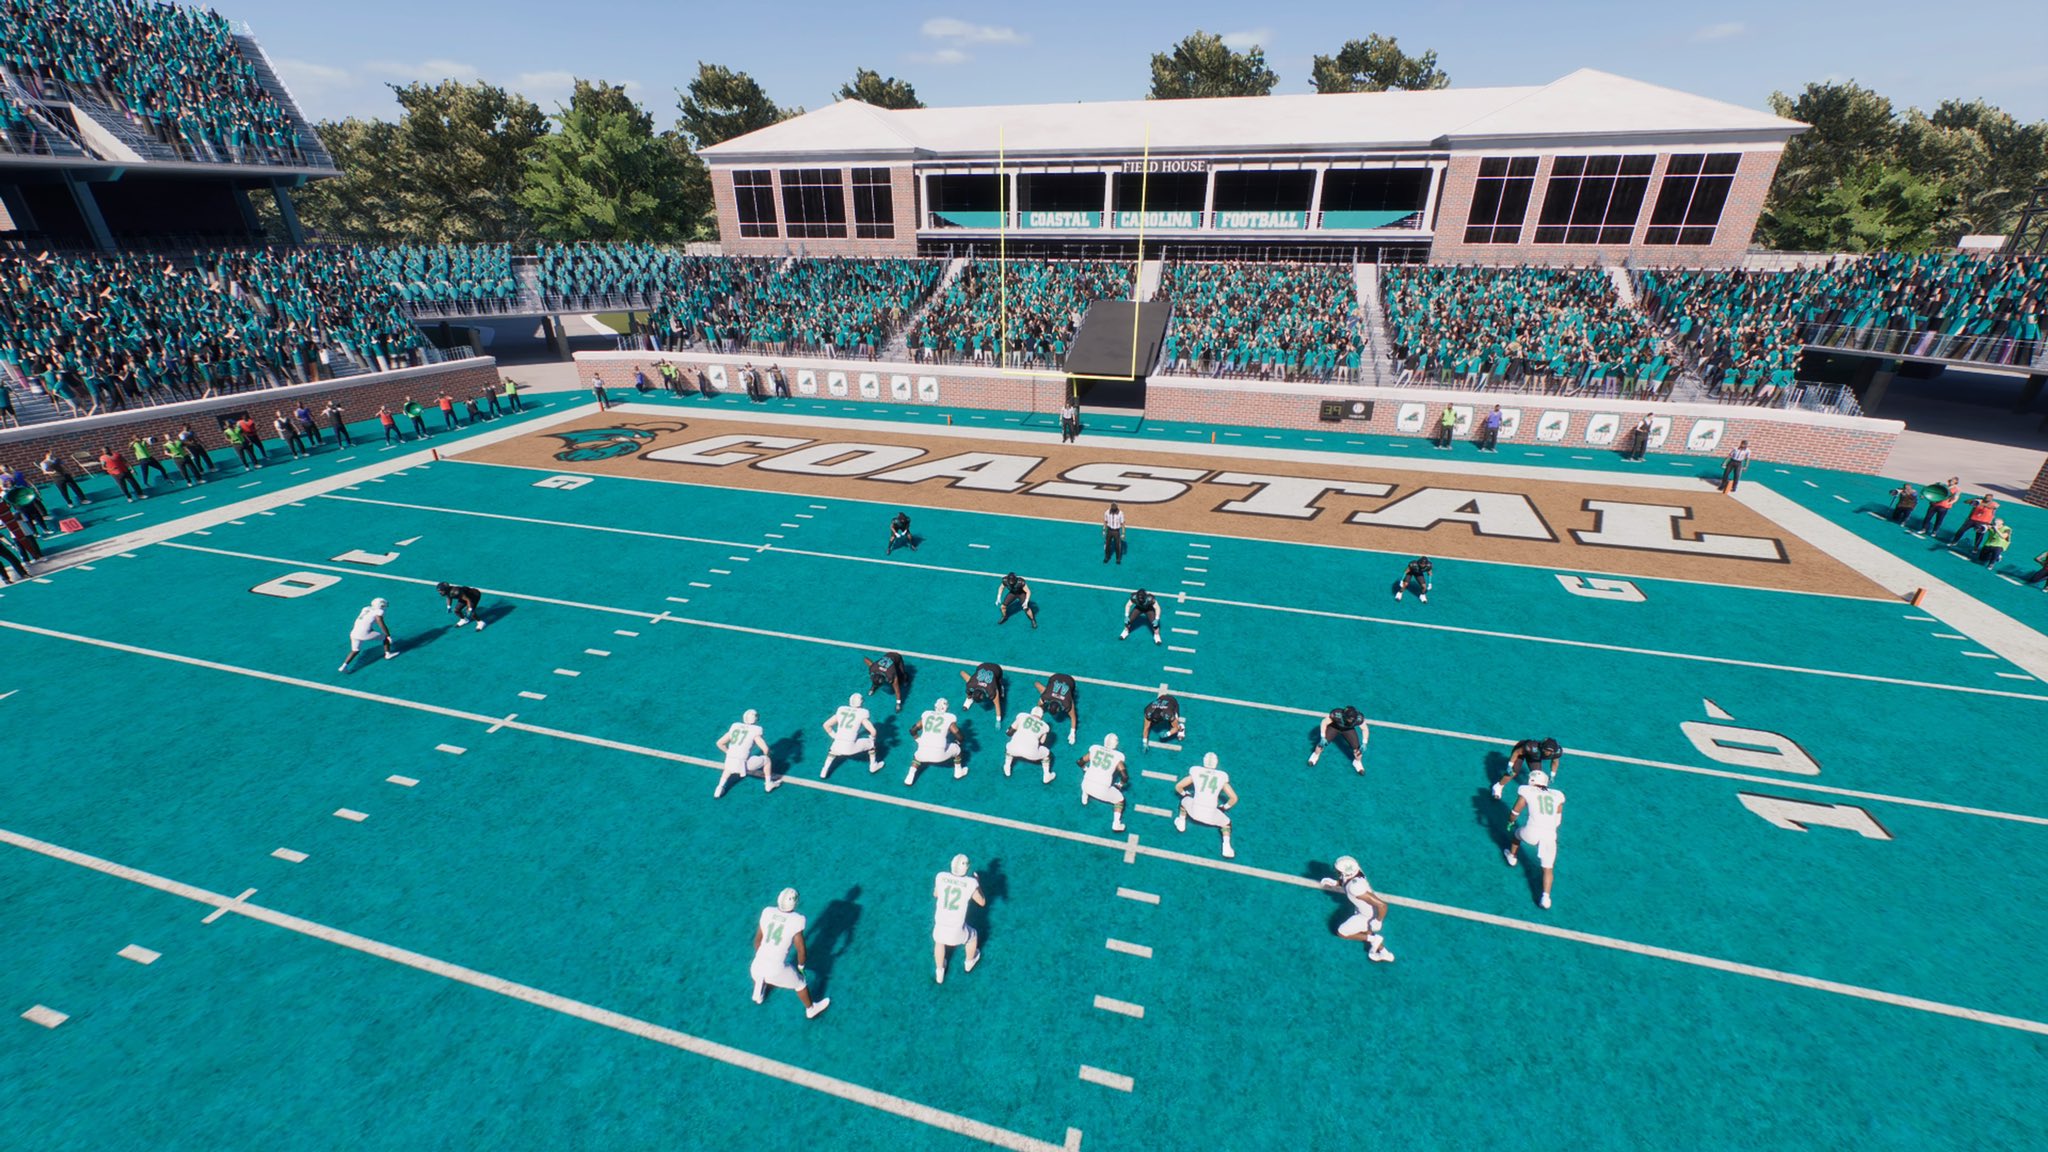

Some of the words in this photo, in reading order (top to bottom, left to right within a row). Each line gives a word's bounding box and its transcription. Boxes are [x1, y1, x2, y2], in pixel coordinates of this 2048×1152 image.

[1162, 160, 1206, 172] HOUSE
[1029, 211, 1091, 227] COASTAL
[1120, 211, 1193, 227] CAROLINA
[1221, 211, 1299, 227] FOOTBALL
[638, 434, 1789, 563] COASTAL
[62, 520, 80, 531] 10
[840, 711, 856, 729] 72
[924, 715, 945, 733] 62
[731, 729, 748, 745] 87
[1092, 750, 1114, 770] 55
[1199, 774, 1218, 794] 74
[1537, 795, 1554, 815] 16
[944, 886, 962, 910] 12
[766, 922, 784, 945] 14
